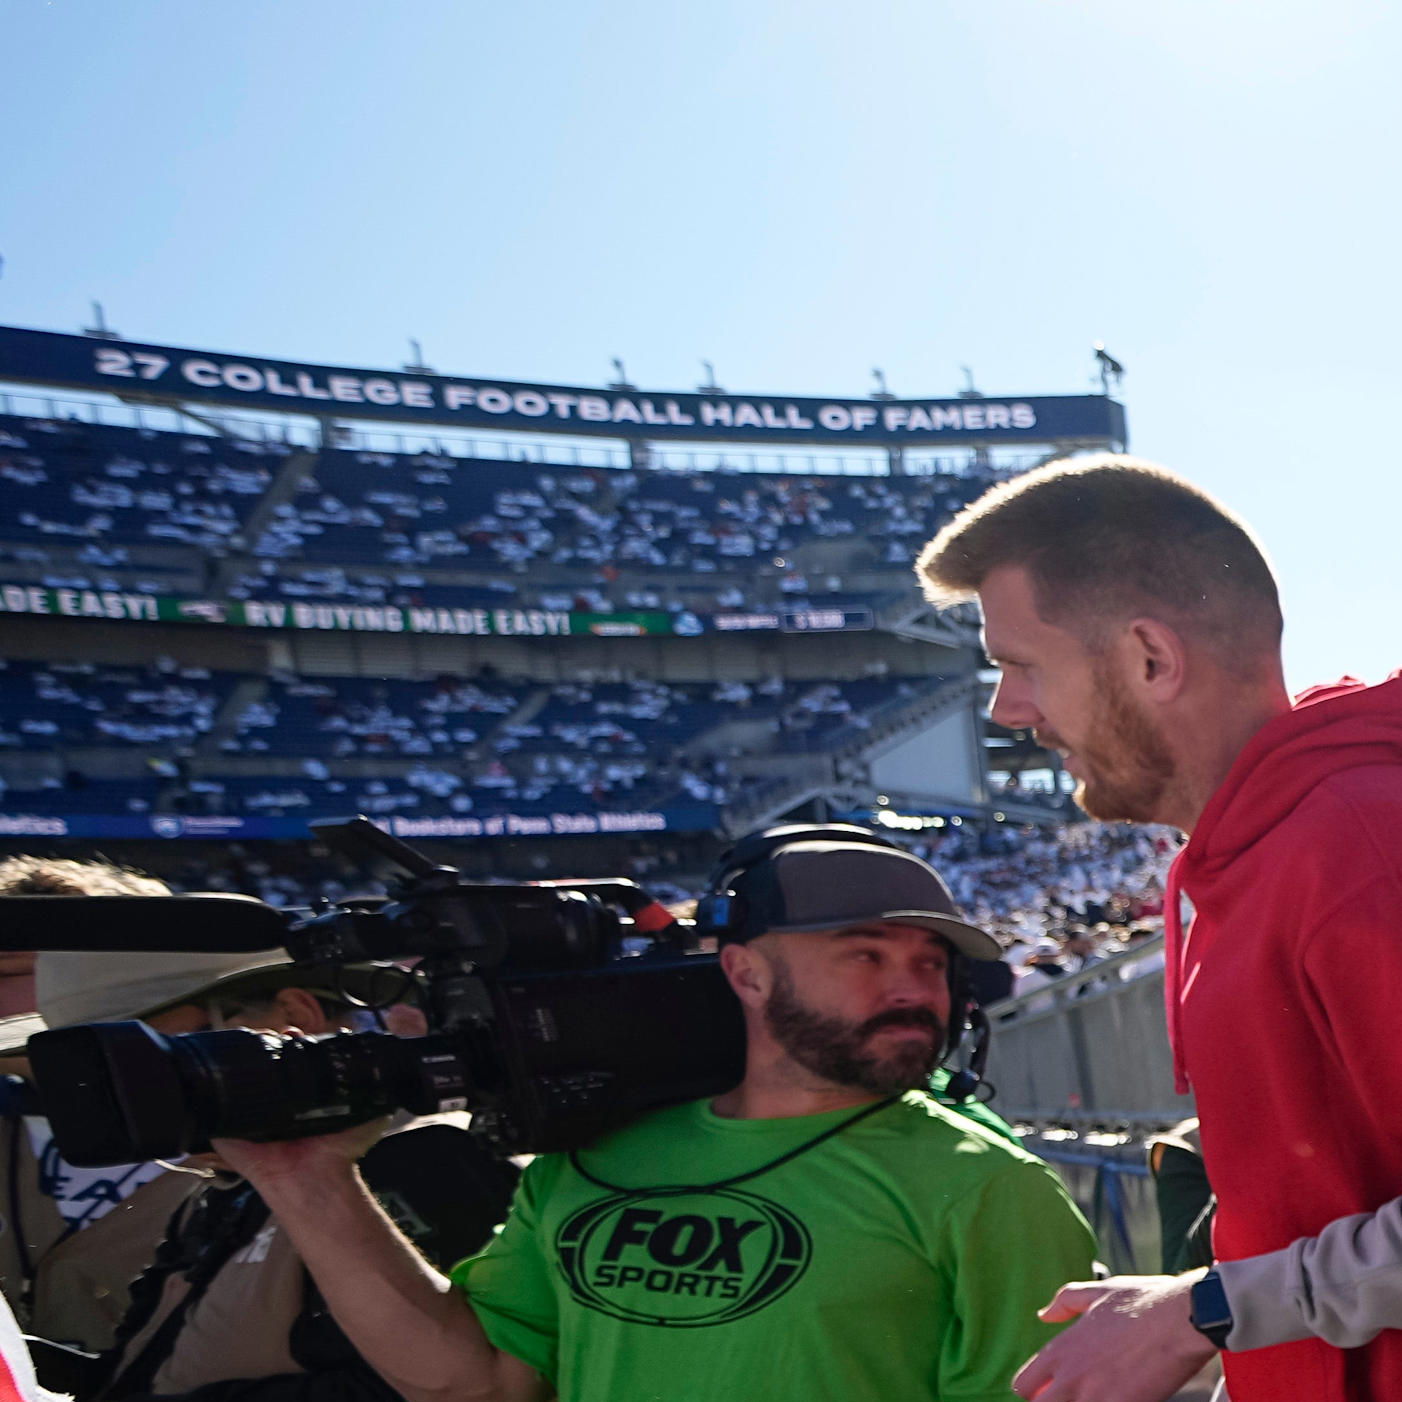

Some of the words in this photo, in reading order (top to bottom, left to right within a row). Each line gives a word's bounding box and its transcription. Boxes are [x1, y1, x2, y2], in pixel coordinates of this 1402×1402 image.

[95, 349, 170, 381] 27
[180, 358, 436, 409] COLLEGE
[444, 385, 694, 426] FOOTBALL
[701, 401, 814, 430] HALL
[819, 405, 878, 432] OF
[884, 402, 1037, 432] FAMERS
[57, 588, 160, 621] EASY!
[245, 601, 286, 627] RV
[291, 601, 404, 632] BUYING
[409, 605, 489, 635] MADE
[494, 608, 571, 635] EASY!
[602, 1207, 767, 1274] FOX
[593, 1264, 743, 1299] SPORTS
